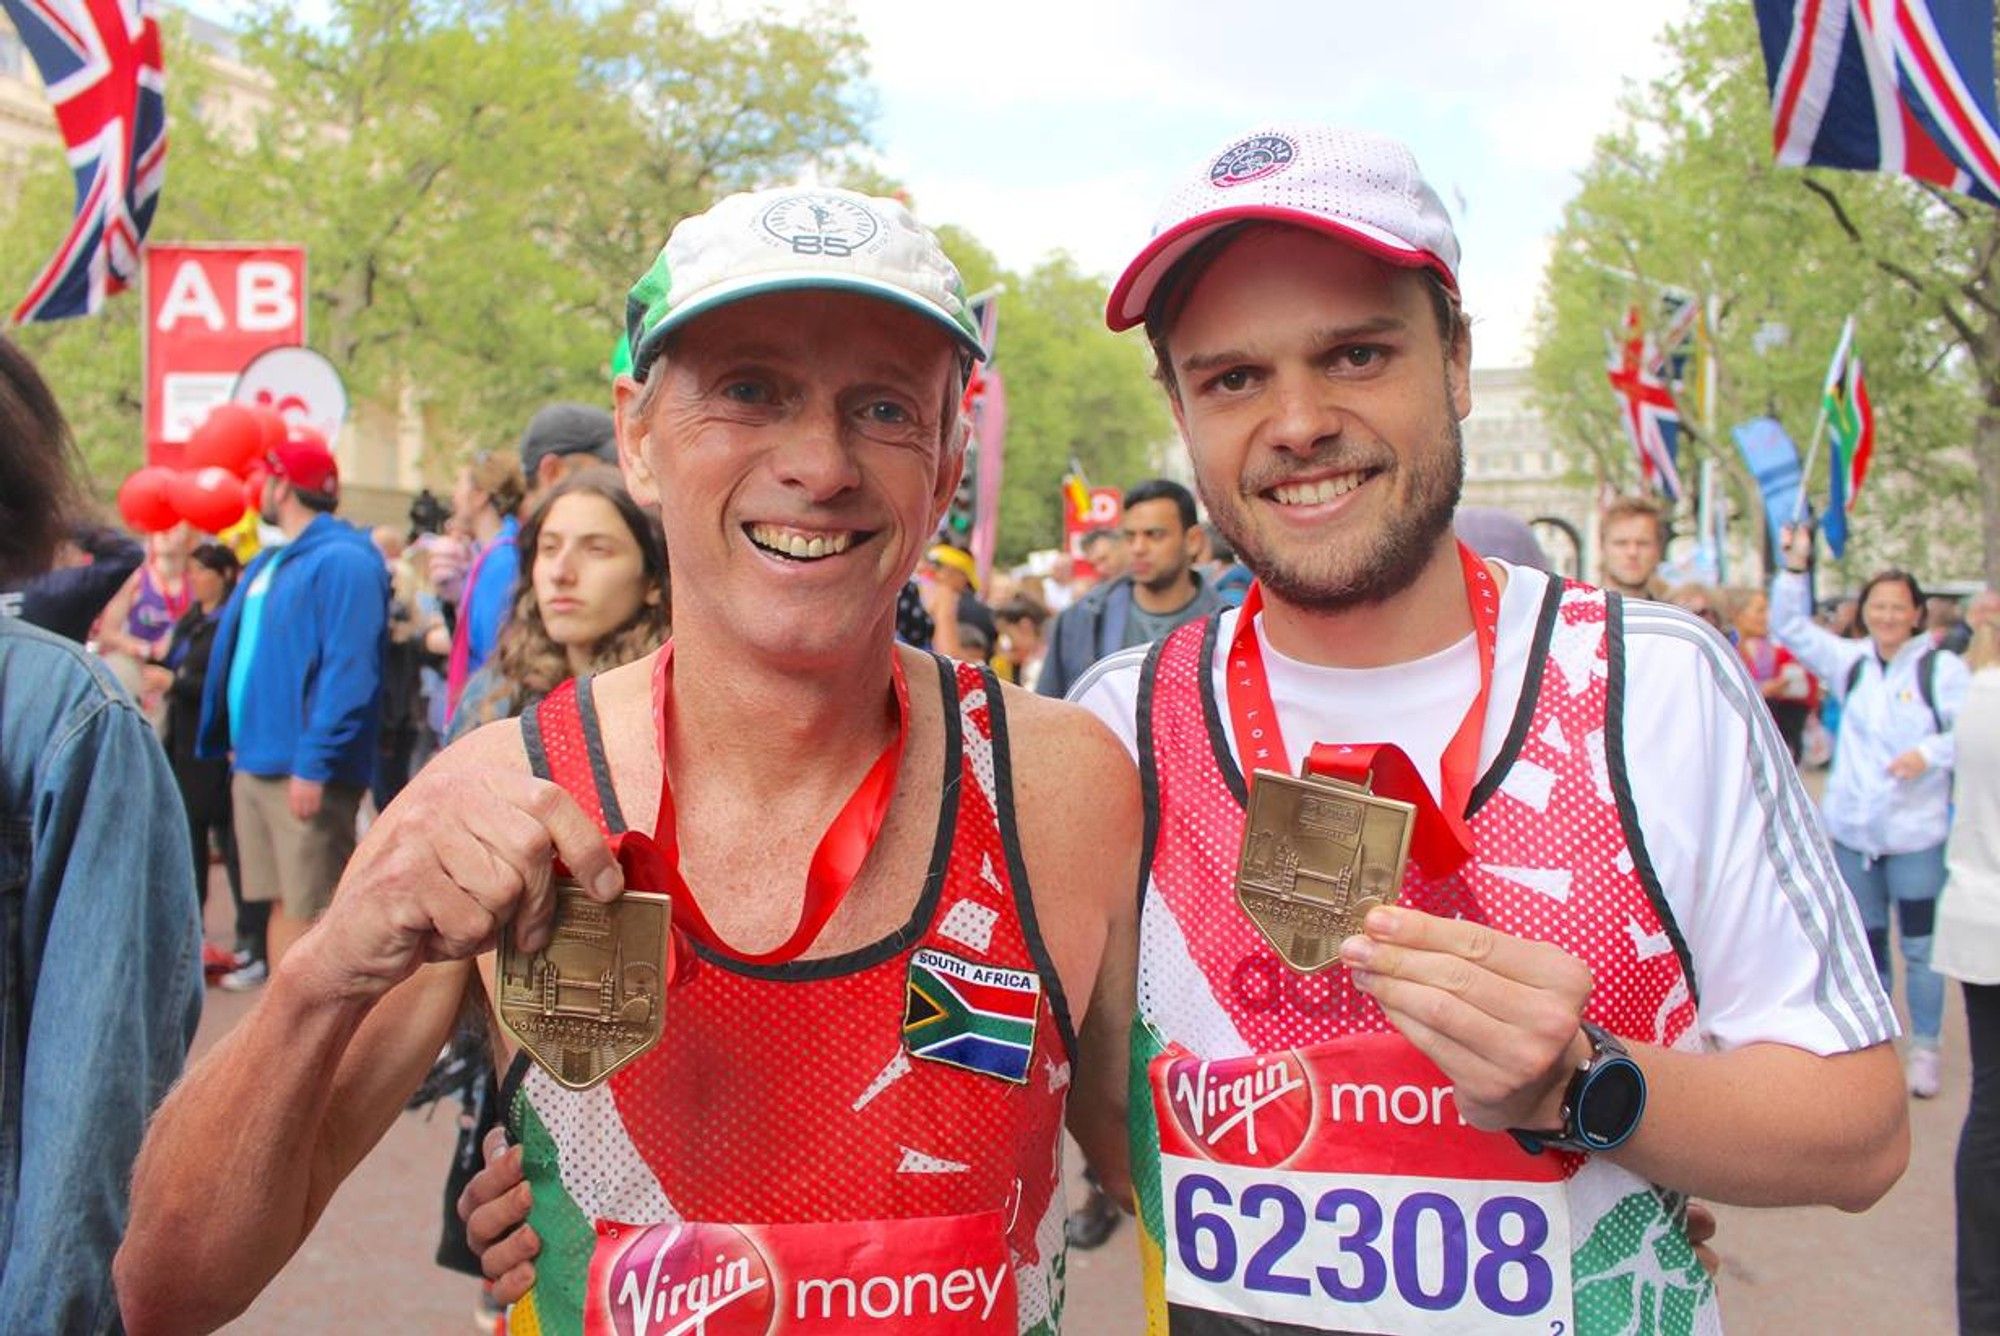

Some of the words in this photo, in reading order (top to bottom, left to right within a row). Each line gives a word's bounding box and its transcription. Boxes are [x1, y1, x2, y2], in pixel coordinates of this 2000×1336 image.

[1084, 494, 1117, 522] D
[919, 952, 966, 977] SOUTH
[973, 968, 1031, 990] AFRICA
[1175, 1061, 1304, 1155] Virgin
[1331, 1082, 1467, 1126] mon
[618, 1224, 768, 1336] Virgin
[796, 1263, 1007, 1321] money
[1175, 1173, 1554, 1317] 62308
